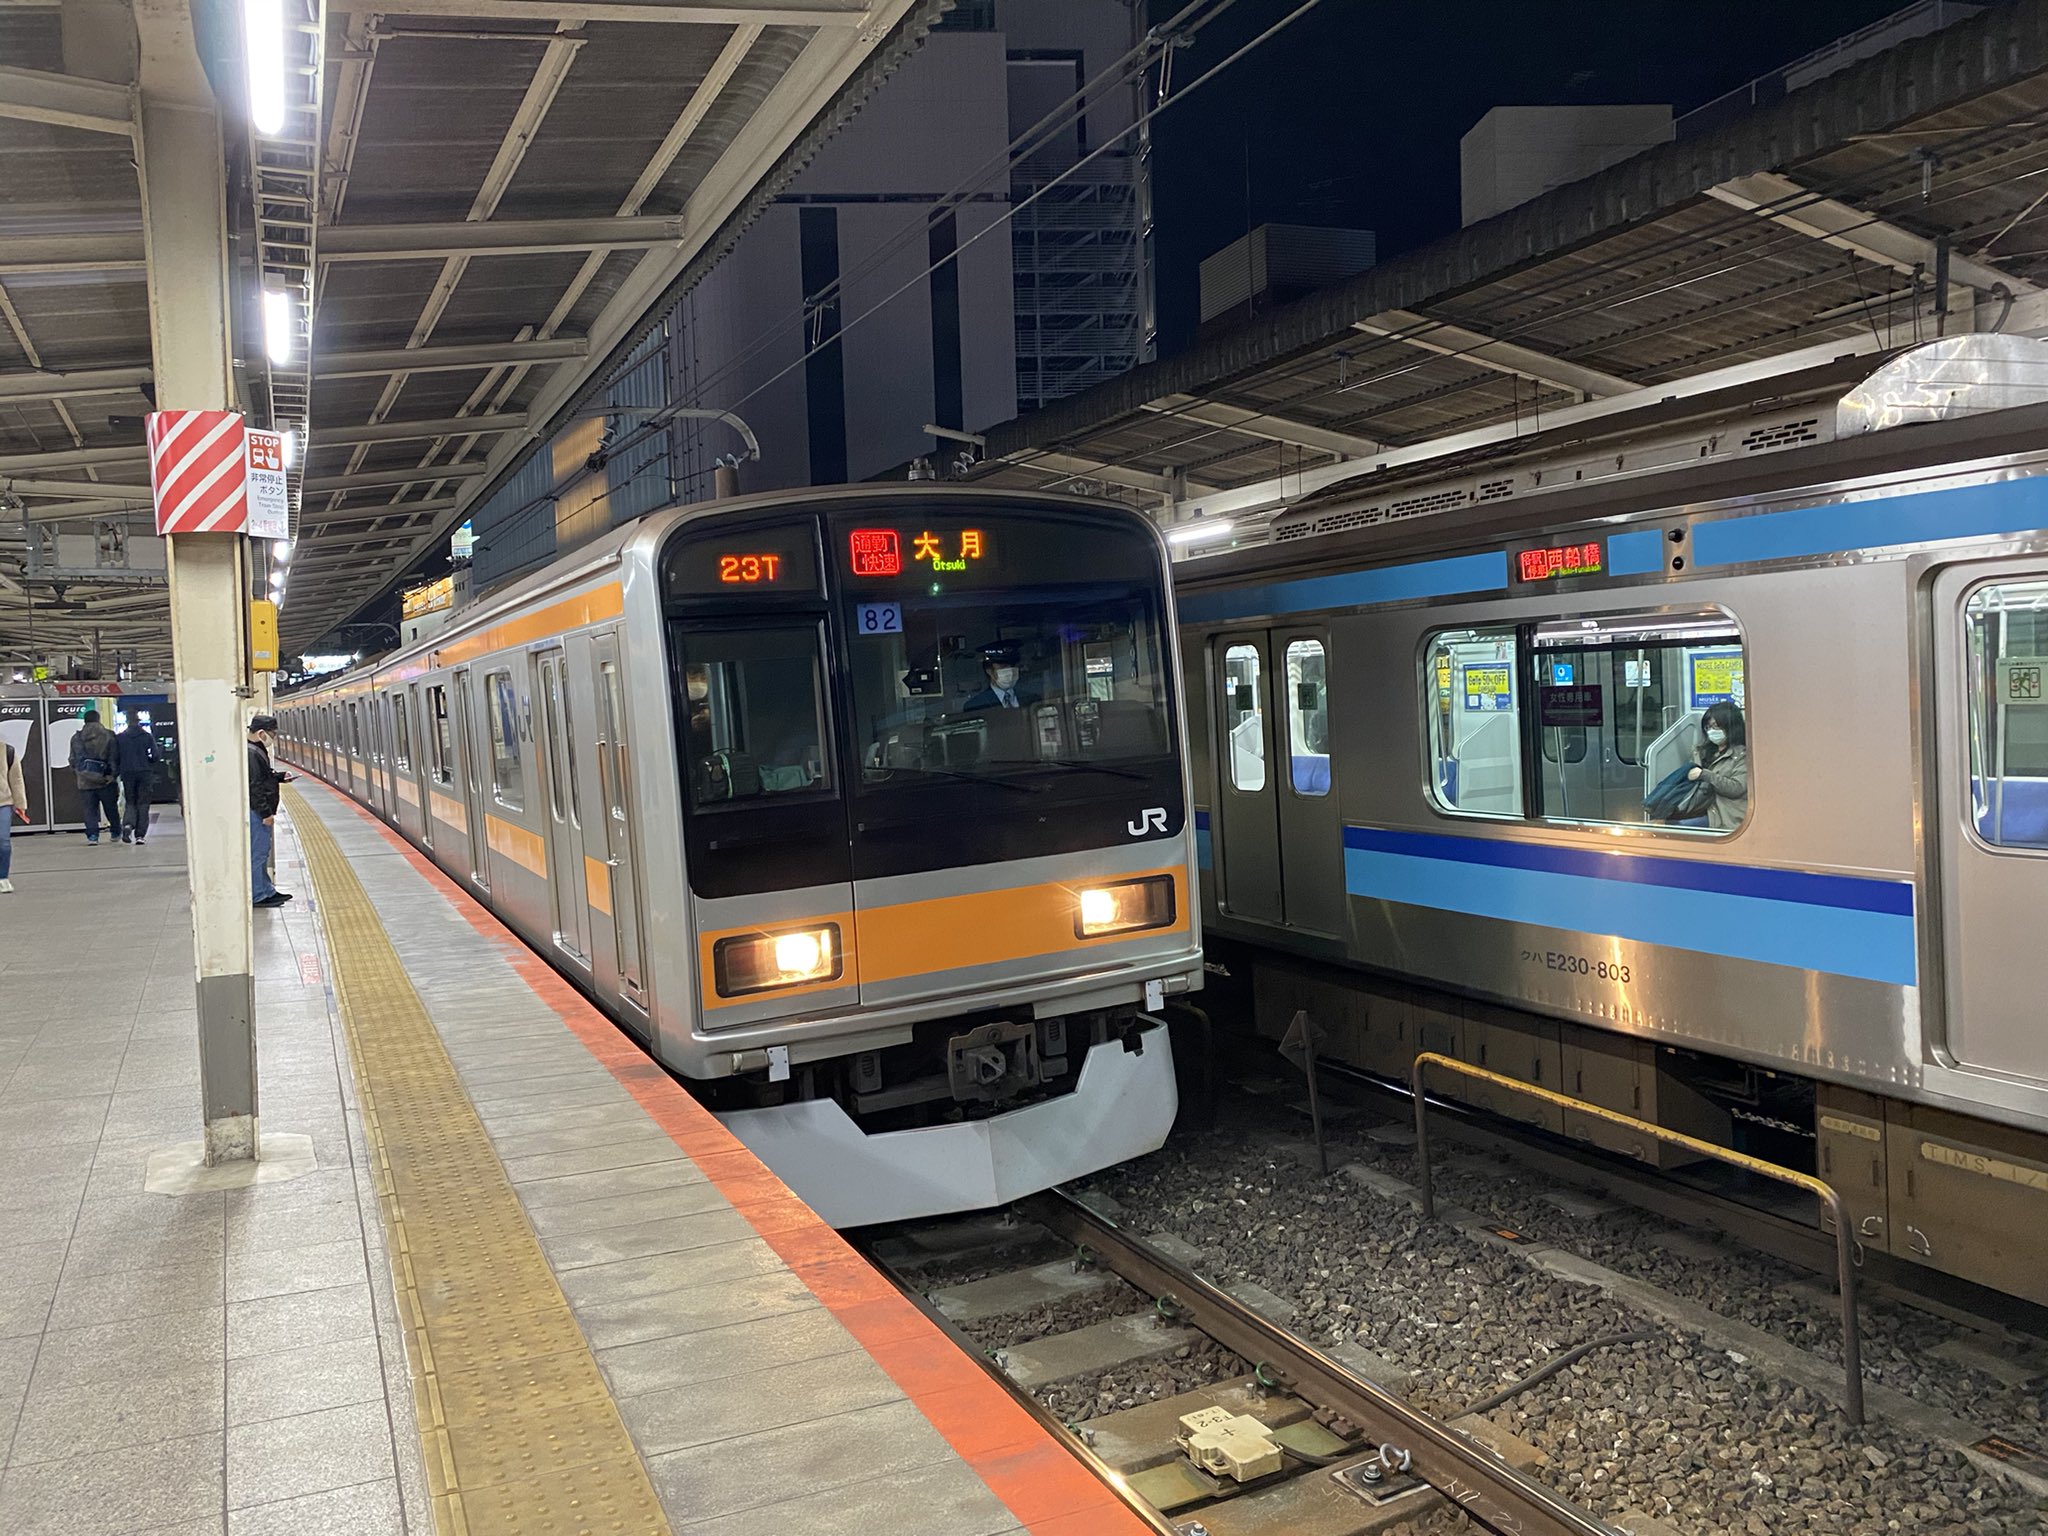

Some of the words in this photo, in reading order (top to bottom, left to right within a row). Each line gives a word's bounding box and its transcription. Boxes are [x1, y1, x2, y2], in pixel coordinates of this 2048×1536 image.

[250, 435, 280, 447] STOP
[250, 472, 284, 485] 非常停止
[260, 486, 284, 496] ボタン
[854, 534, 888, 553] 通勤
[913, 531, 981, 559] 大月
[861, 553, 896, 572] 快速
[1547, 543, 1600, 568] 西船橋
[720, 555, 779, 582] 23T
[865, 609, 896, 631] 82
[1, 706, 31, 714] acure
[57, 705, 87, 714] acure
[1127, 807, 1168, 836] JR
[1520, 950, 1543, 964] クハ
[1546, 952, 1631, 983] E230-803
[1928, 1145, 1986, 1172] TIMS
